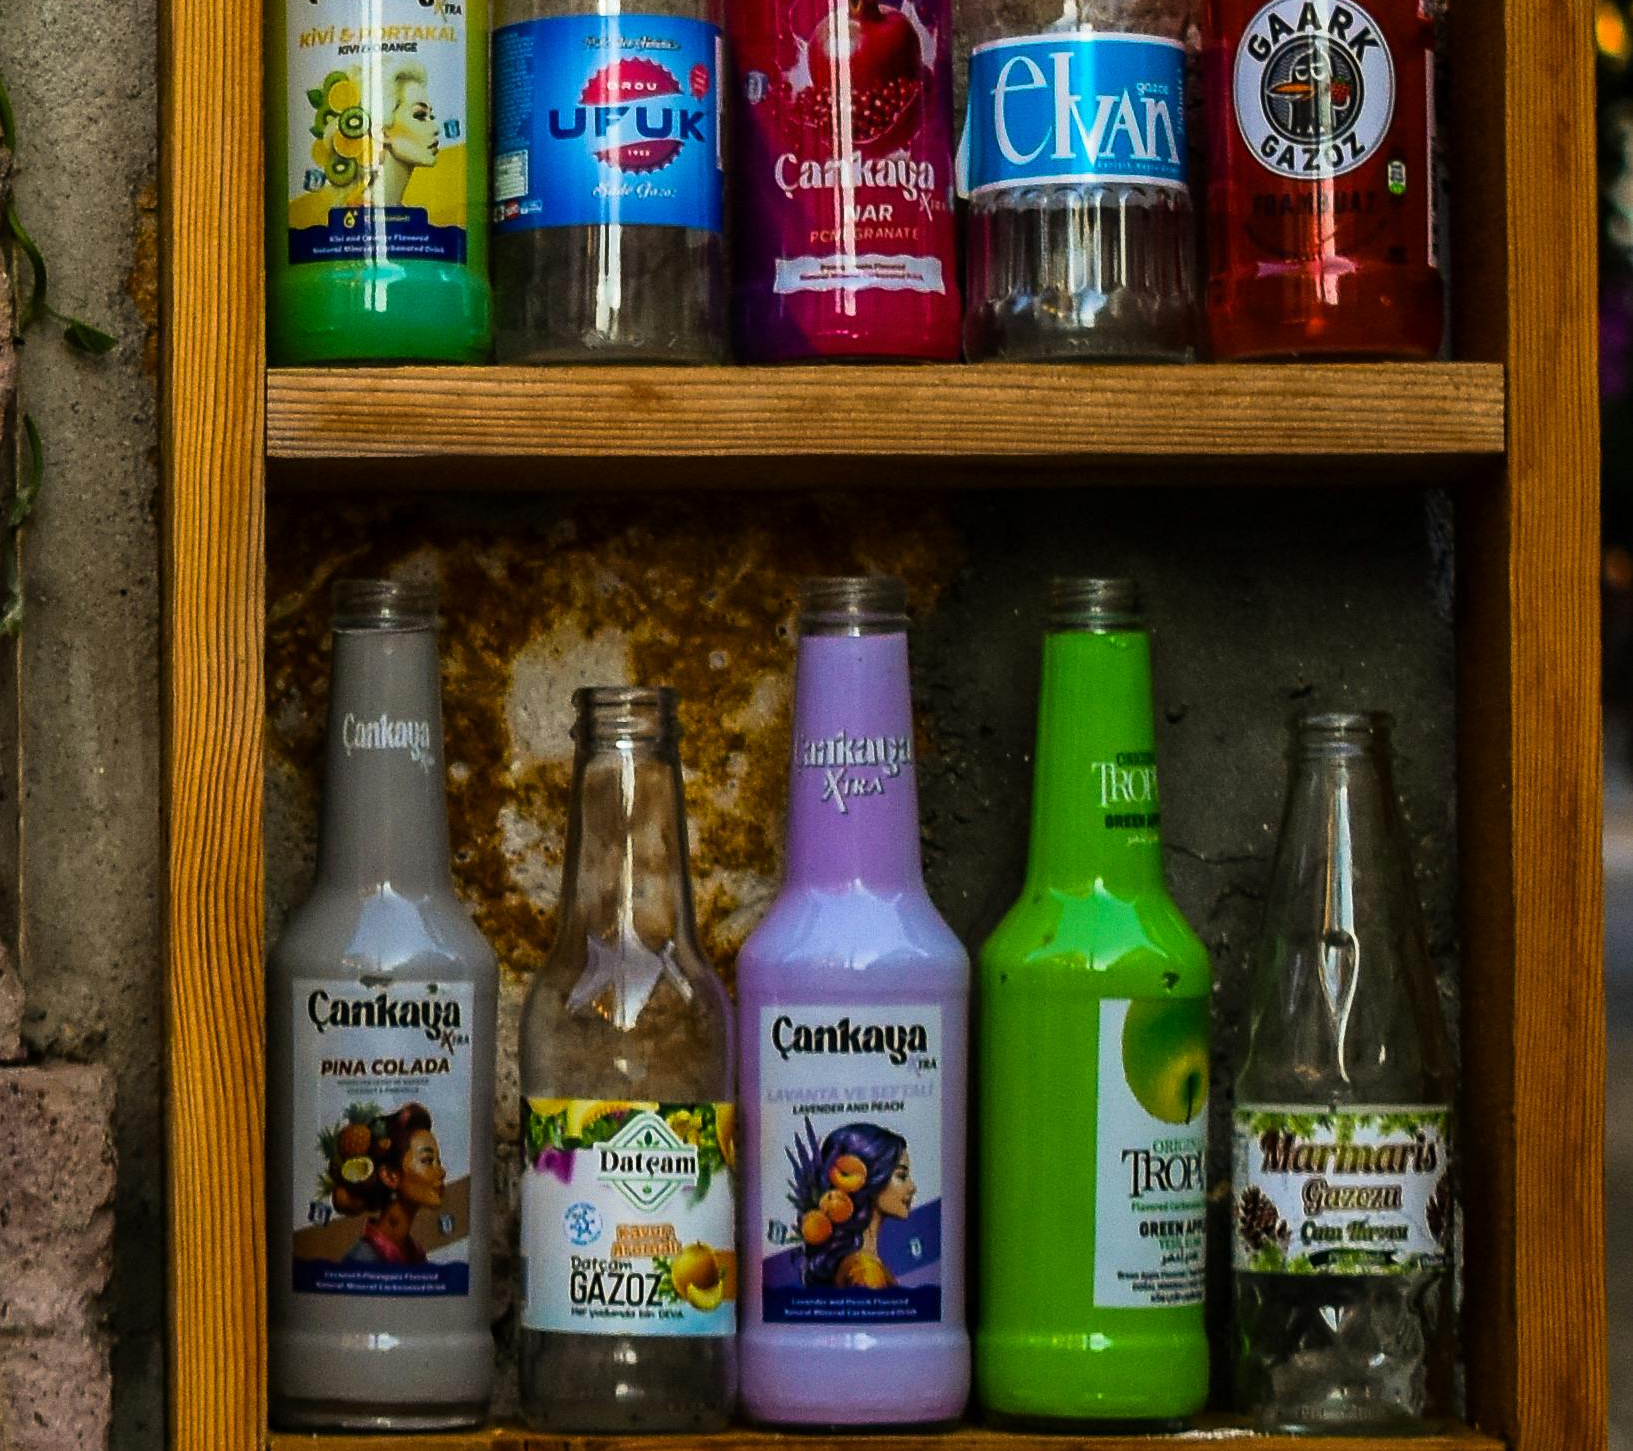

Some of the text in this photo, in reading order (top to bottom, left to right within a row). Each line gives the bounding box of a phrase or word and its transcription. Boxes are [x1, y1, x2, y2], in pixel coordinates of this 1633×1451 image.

[299, 25, 334, 49] KİVİ
[375, 42, 418, 55] RANGE
[1247, 1, 1380, 64] GAARK
[548, 106, 707, 143] UFUK
[1260, 131, 1366, 172] GAZOZ
[774, 148, 936, 202] Çankaya
[343, 712, 430, 761] Çankaya
[821, 767, 885, 814] XTRA
[308, 989, 462, 1041] Çankaya
[772, 1015, 928, 1065] Çankaya
[320, 1057, 451, 1077] PINA COLADA
[846, 1101, 870, 1113] AND
[871, 1100, 905, 1112] PEACH
[600, 1150, 696, 1180] Datçam
[1259, 1131, 1438, 1174] Marmaris
[1138, 1220, 1184, 1238] GREEN
[571, 1254, 633, 1276] Datçam
[570, 1270, 664, 1307] GAZOZ
